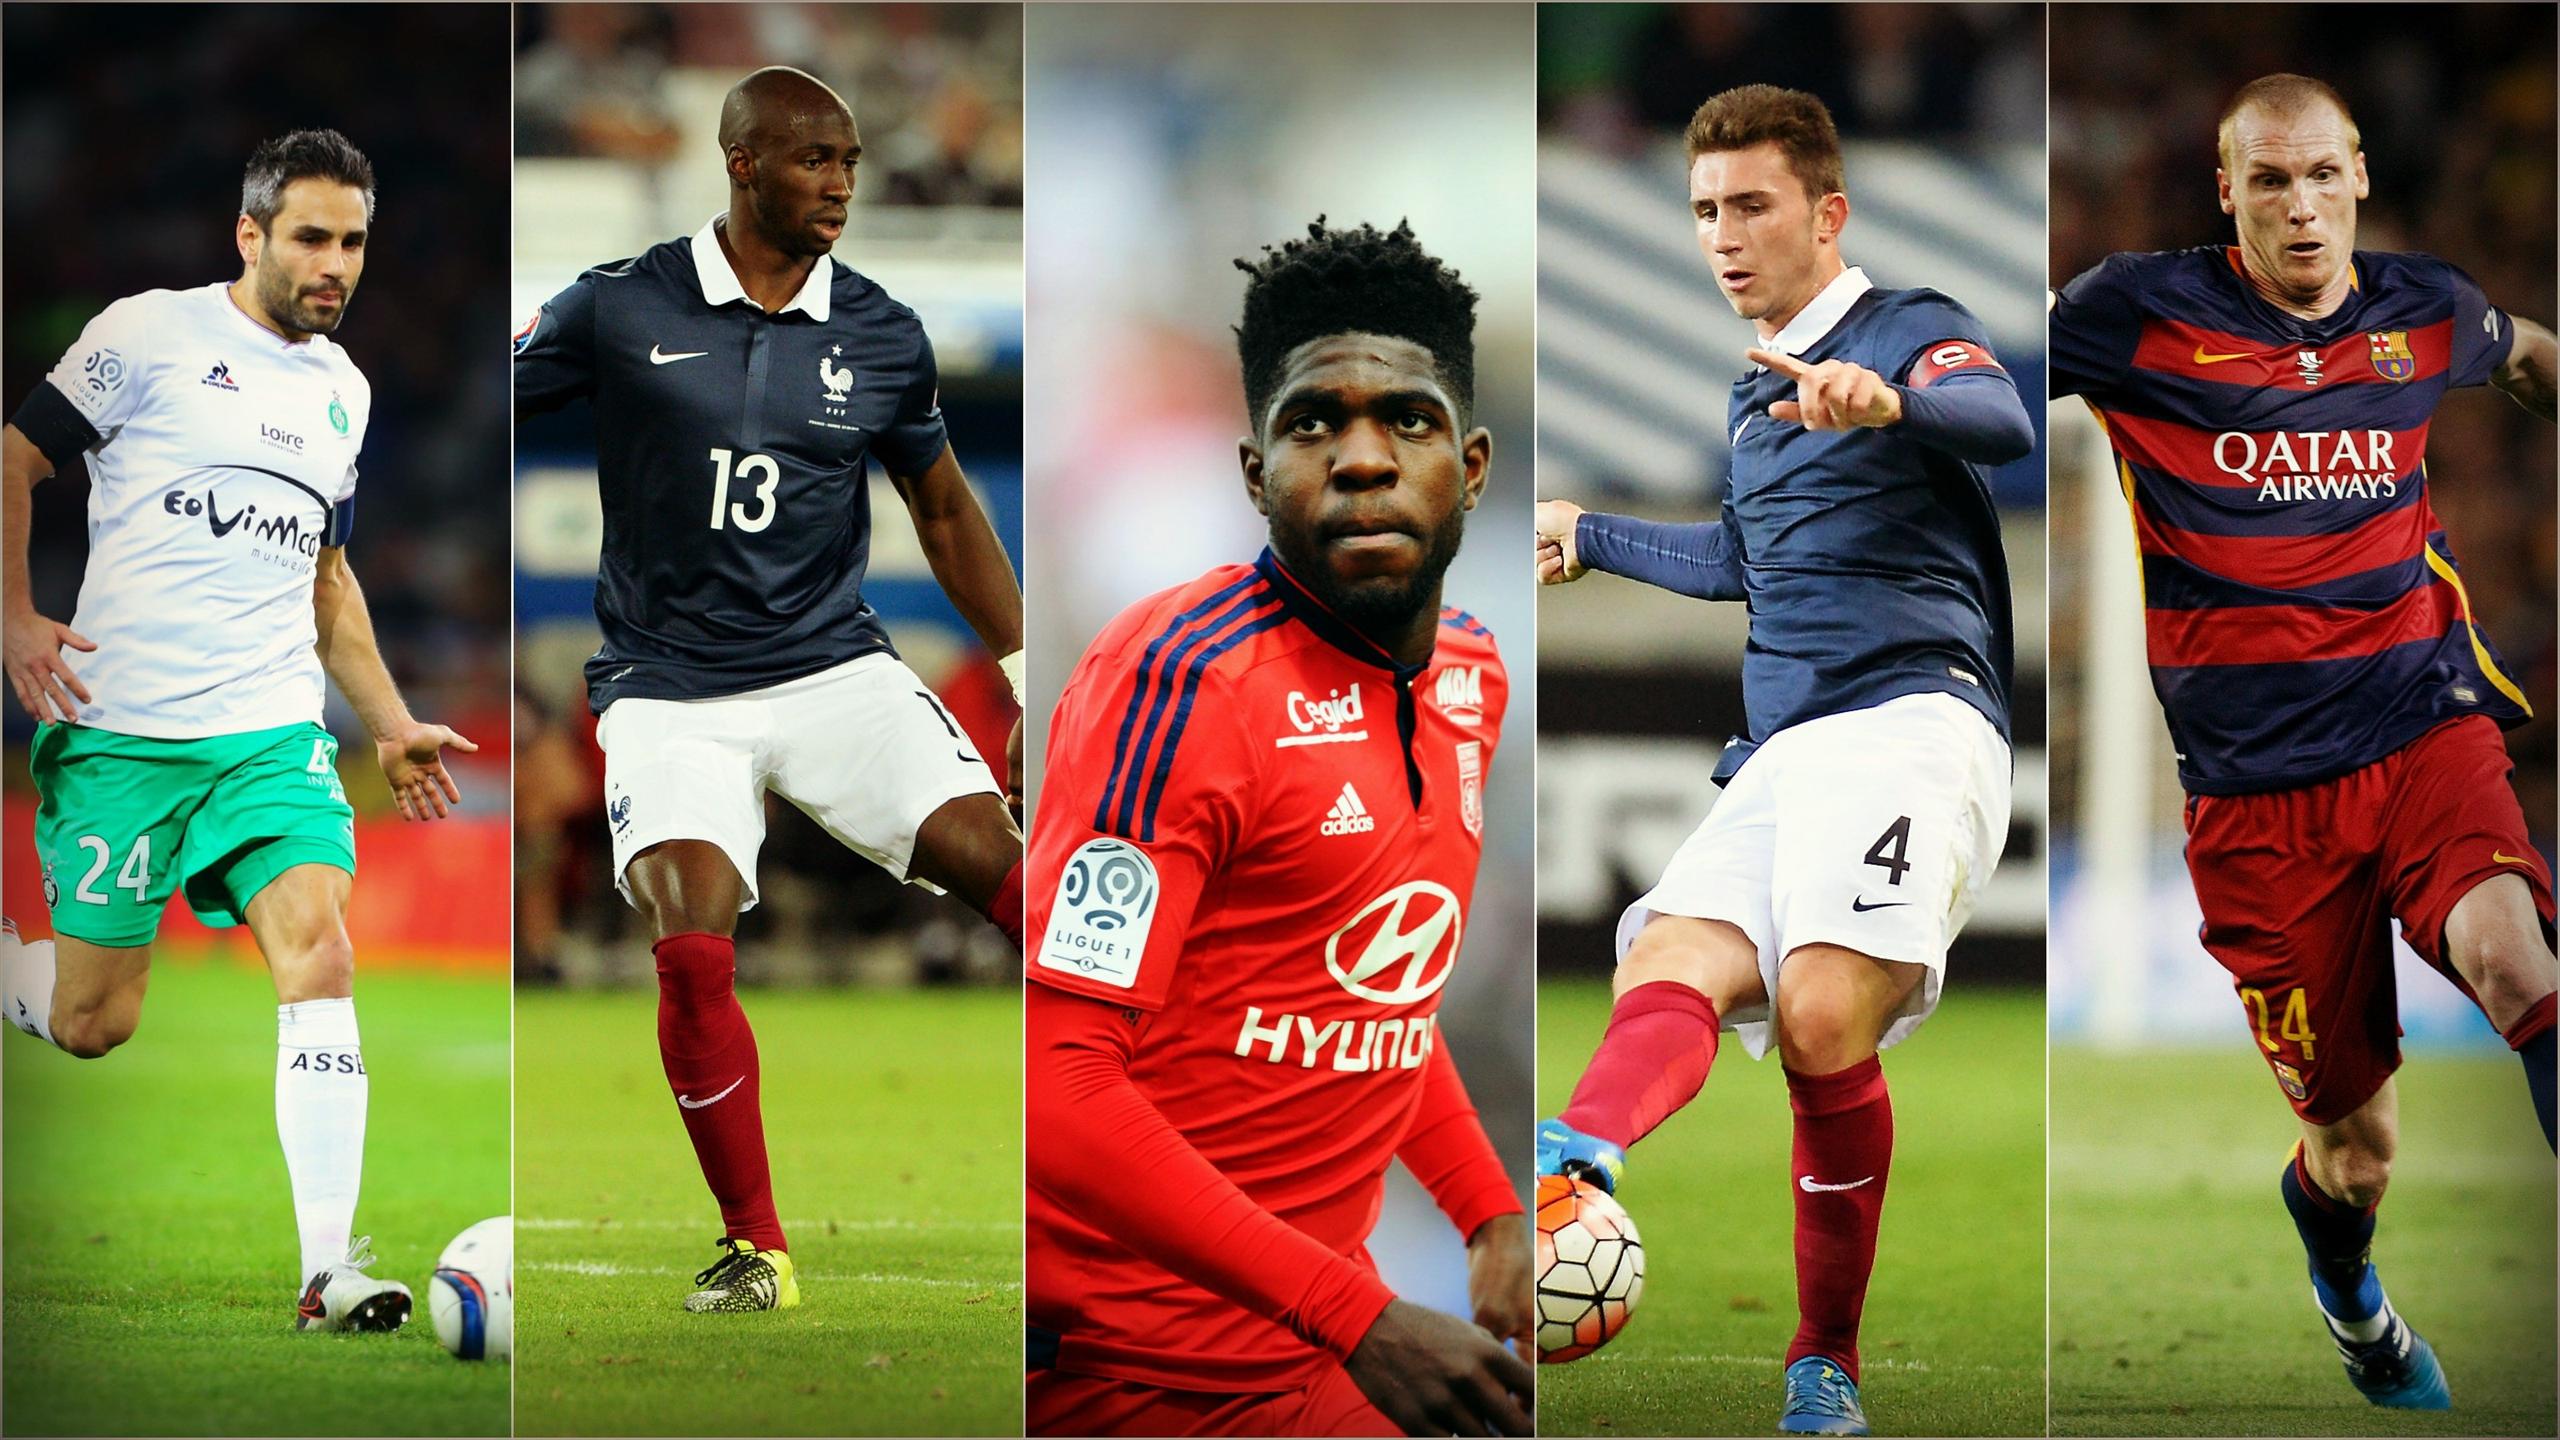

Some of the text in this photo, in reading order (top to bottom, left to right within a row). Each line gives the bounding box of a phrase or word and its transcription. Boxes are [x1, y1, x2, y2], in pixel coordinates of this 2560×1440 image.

[2213, 429, 2396, 483] QATAR
[709, 447, 780, 533] 13
[2257, 472, 2396, 502] AIRWAYS
[1287, 682, 1365, 733] Cegid
[1320, 815, 1375, 837] adidas
[1863, 815, 1911, 886] 4
[75, 834, 151, 906] 24
[1055, 930, 1131, 960] LIGUE 1
[2241, 987, 2317, 1061] 24
